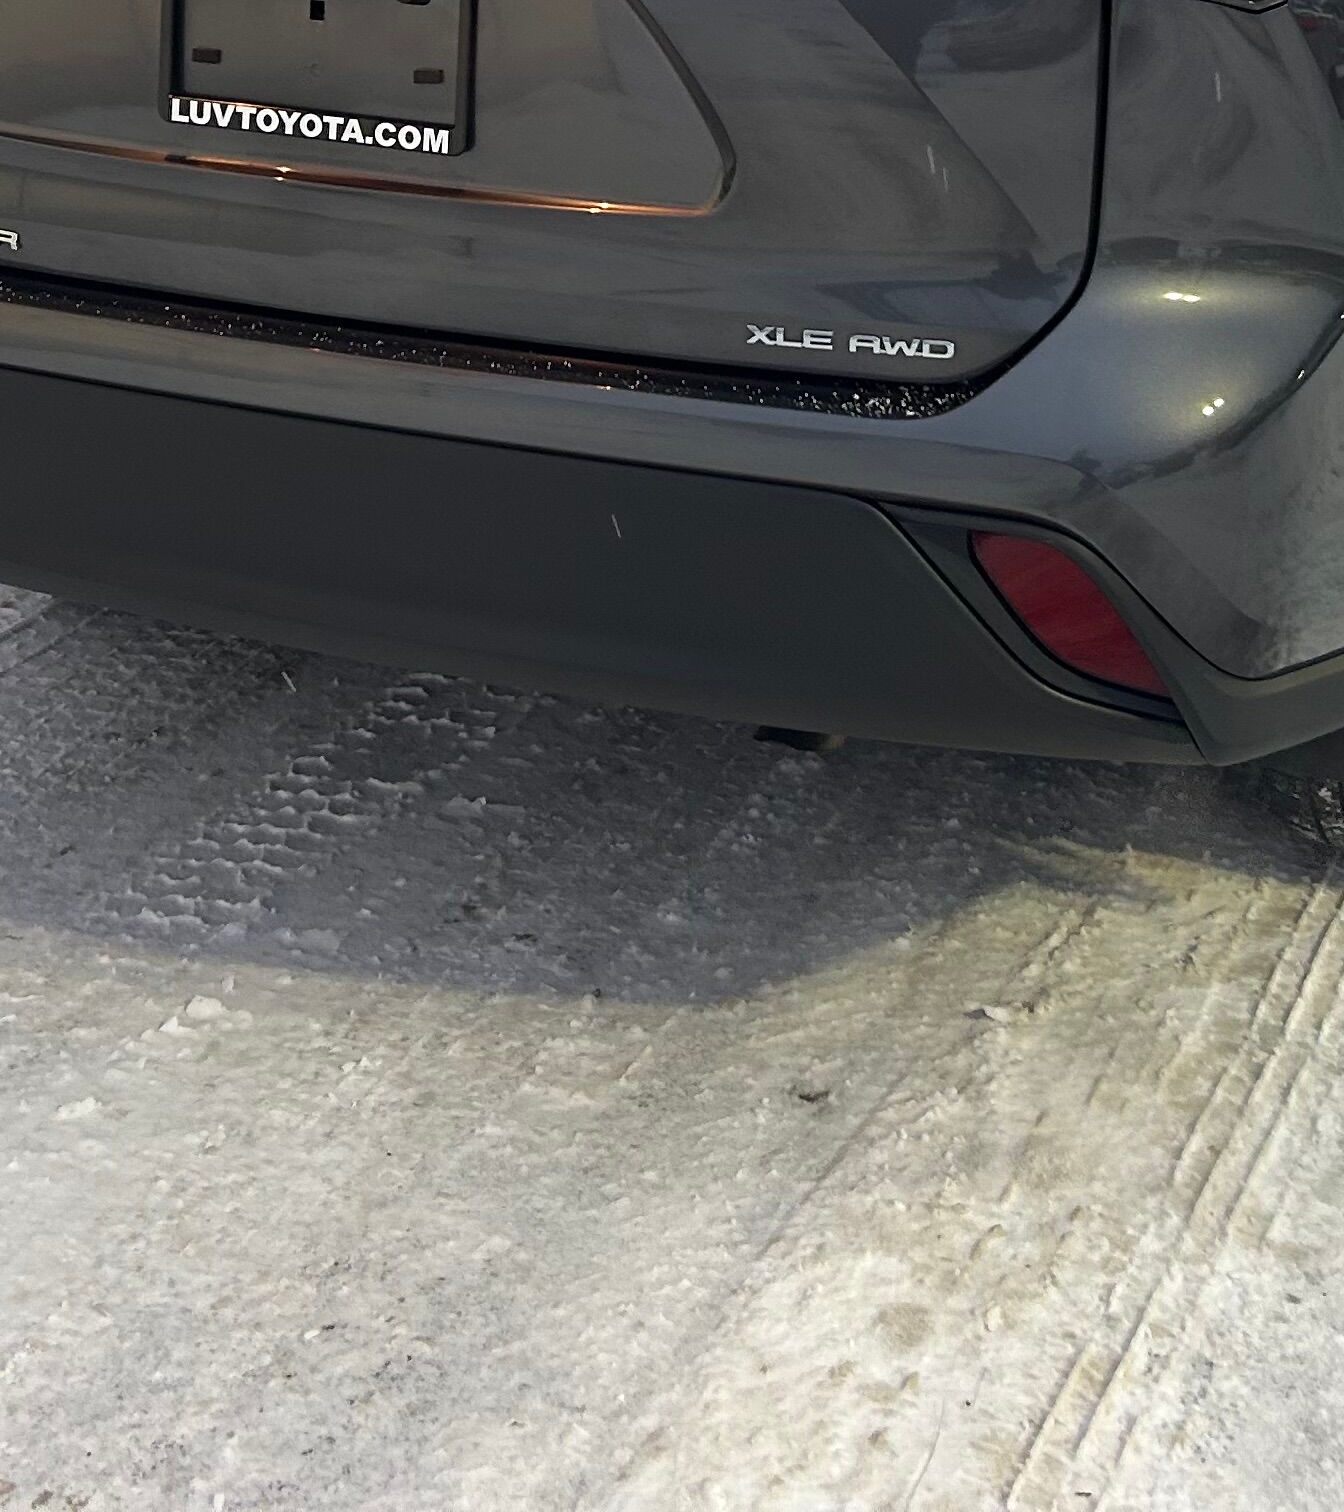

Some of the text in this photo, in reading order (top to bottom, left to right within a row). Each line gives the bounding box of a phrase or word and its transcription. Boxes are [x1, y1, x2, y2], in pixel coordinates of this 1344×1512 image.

[170, 97, 450, 155] LUVTOYOTA.COM
[746, 324, 955, 359] XLE AWD
